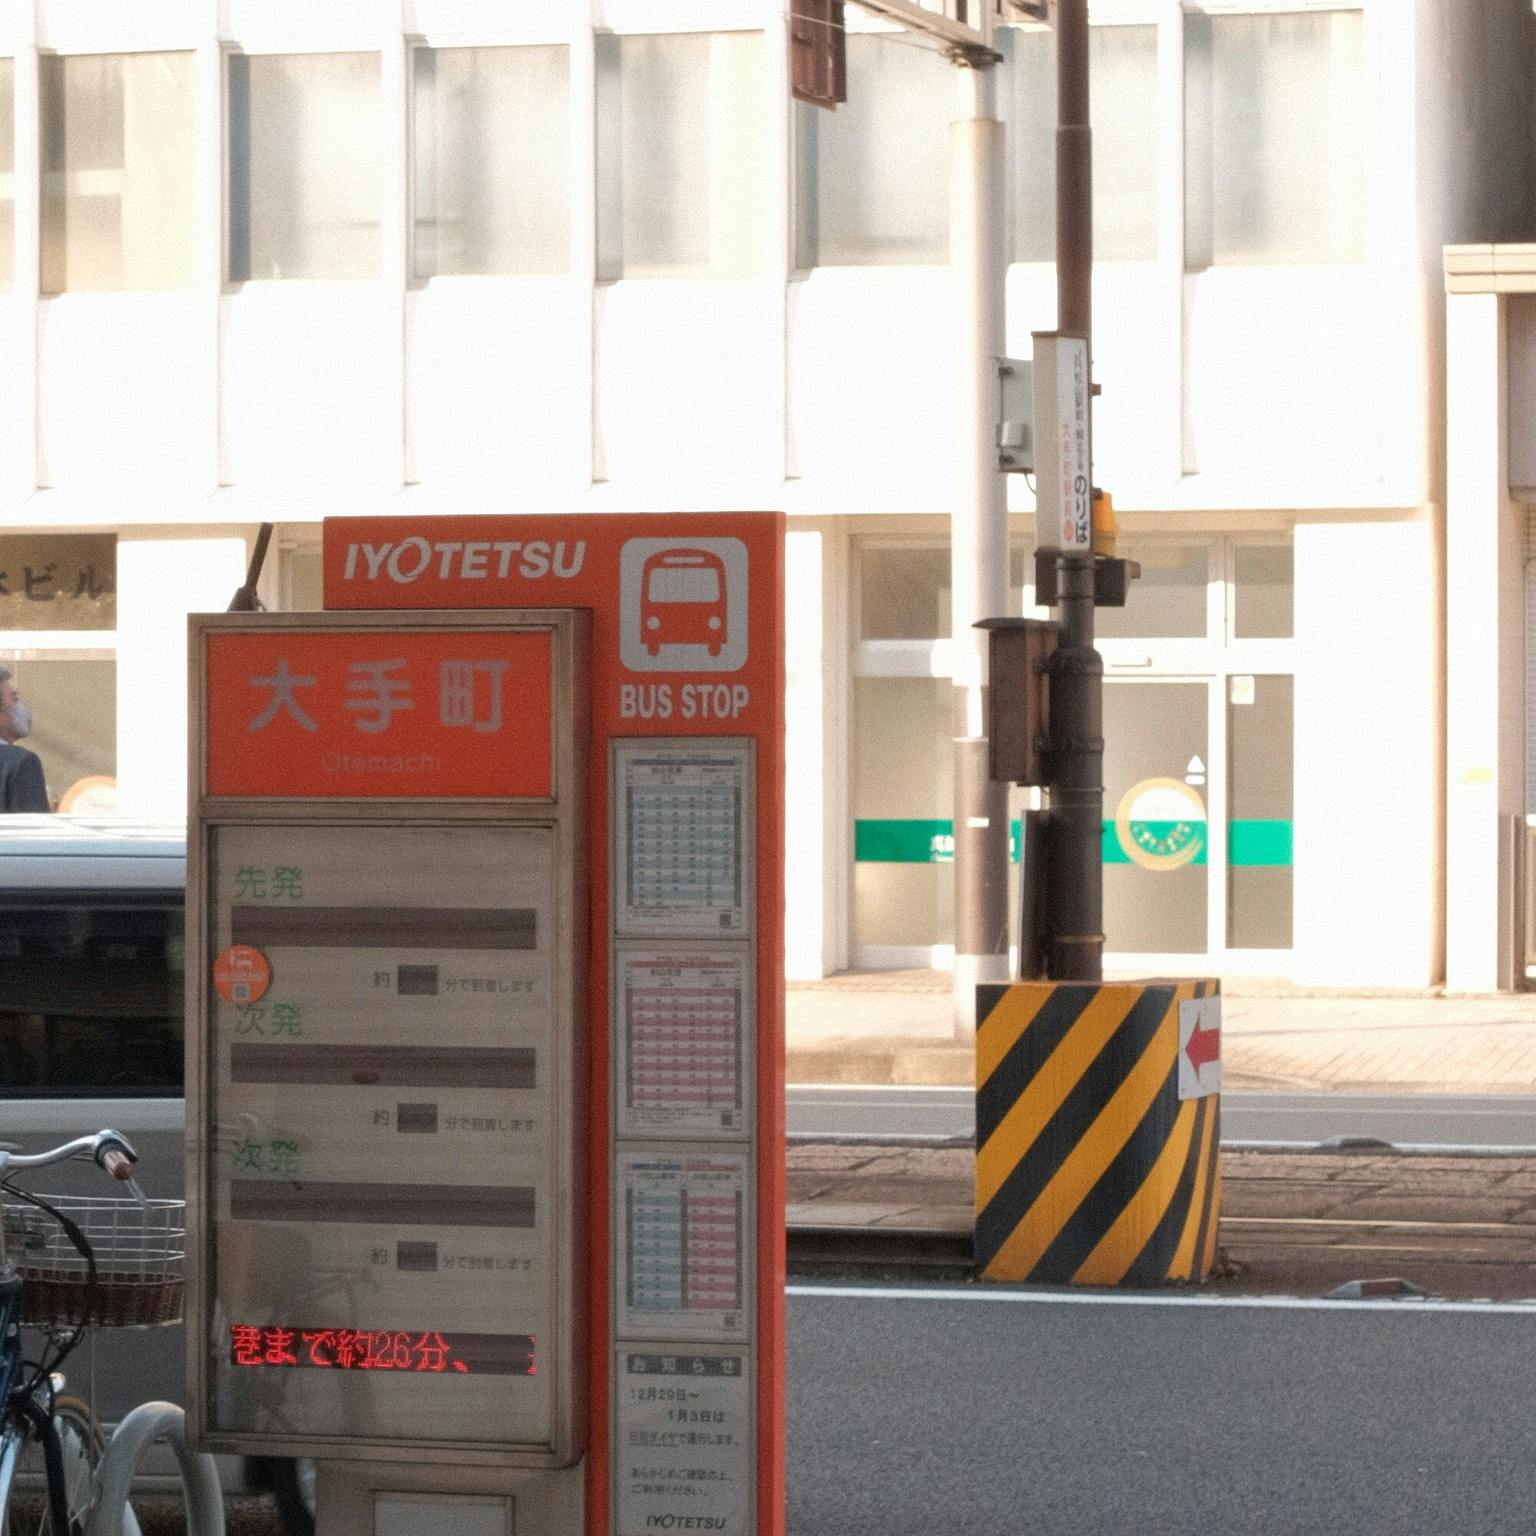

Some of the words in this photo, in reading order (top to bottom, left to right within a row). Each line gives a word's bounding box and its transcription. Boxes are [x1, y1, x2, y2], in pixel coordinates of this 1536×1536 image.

[343, 535, 587, 583] IYOTETSU
[246, 657, 510, 734] 大手町
[619, 683, 673, 719] BUS
[680, 683, 751, 719] STOP
[234, 865, 304, 900] 先発
[372, 971, 391, 989] 約
[445, 977, 536, 994] 分で到着します
[234, 1001, 304, 1037] 次発
[371, 1109, 390, 1126] 約
[445, 1117, 536, 1132] 分で到着します
[631, 1356, 737, 1375] お知らせ
[667, 1410, 725, 1424] 1月3日は
[645, 1513, 726, 1530] IYOTETSU
